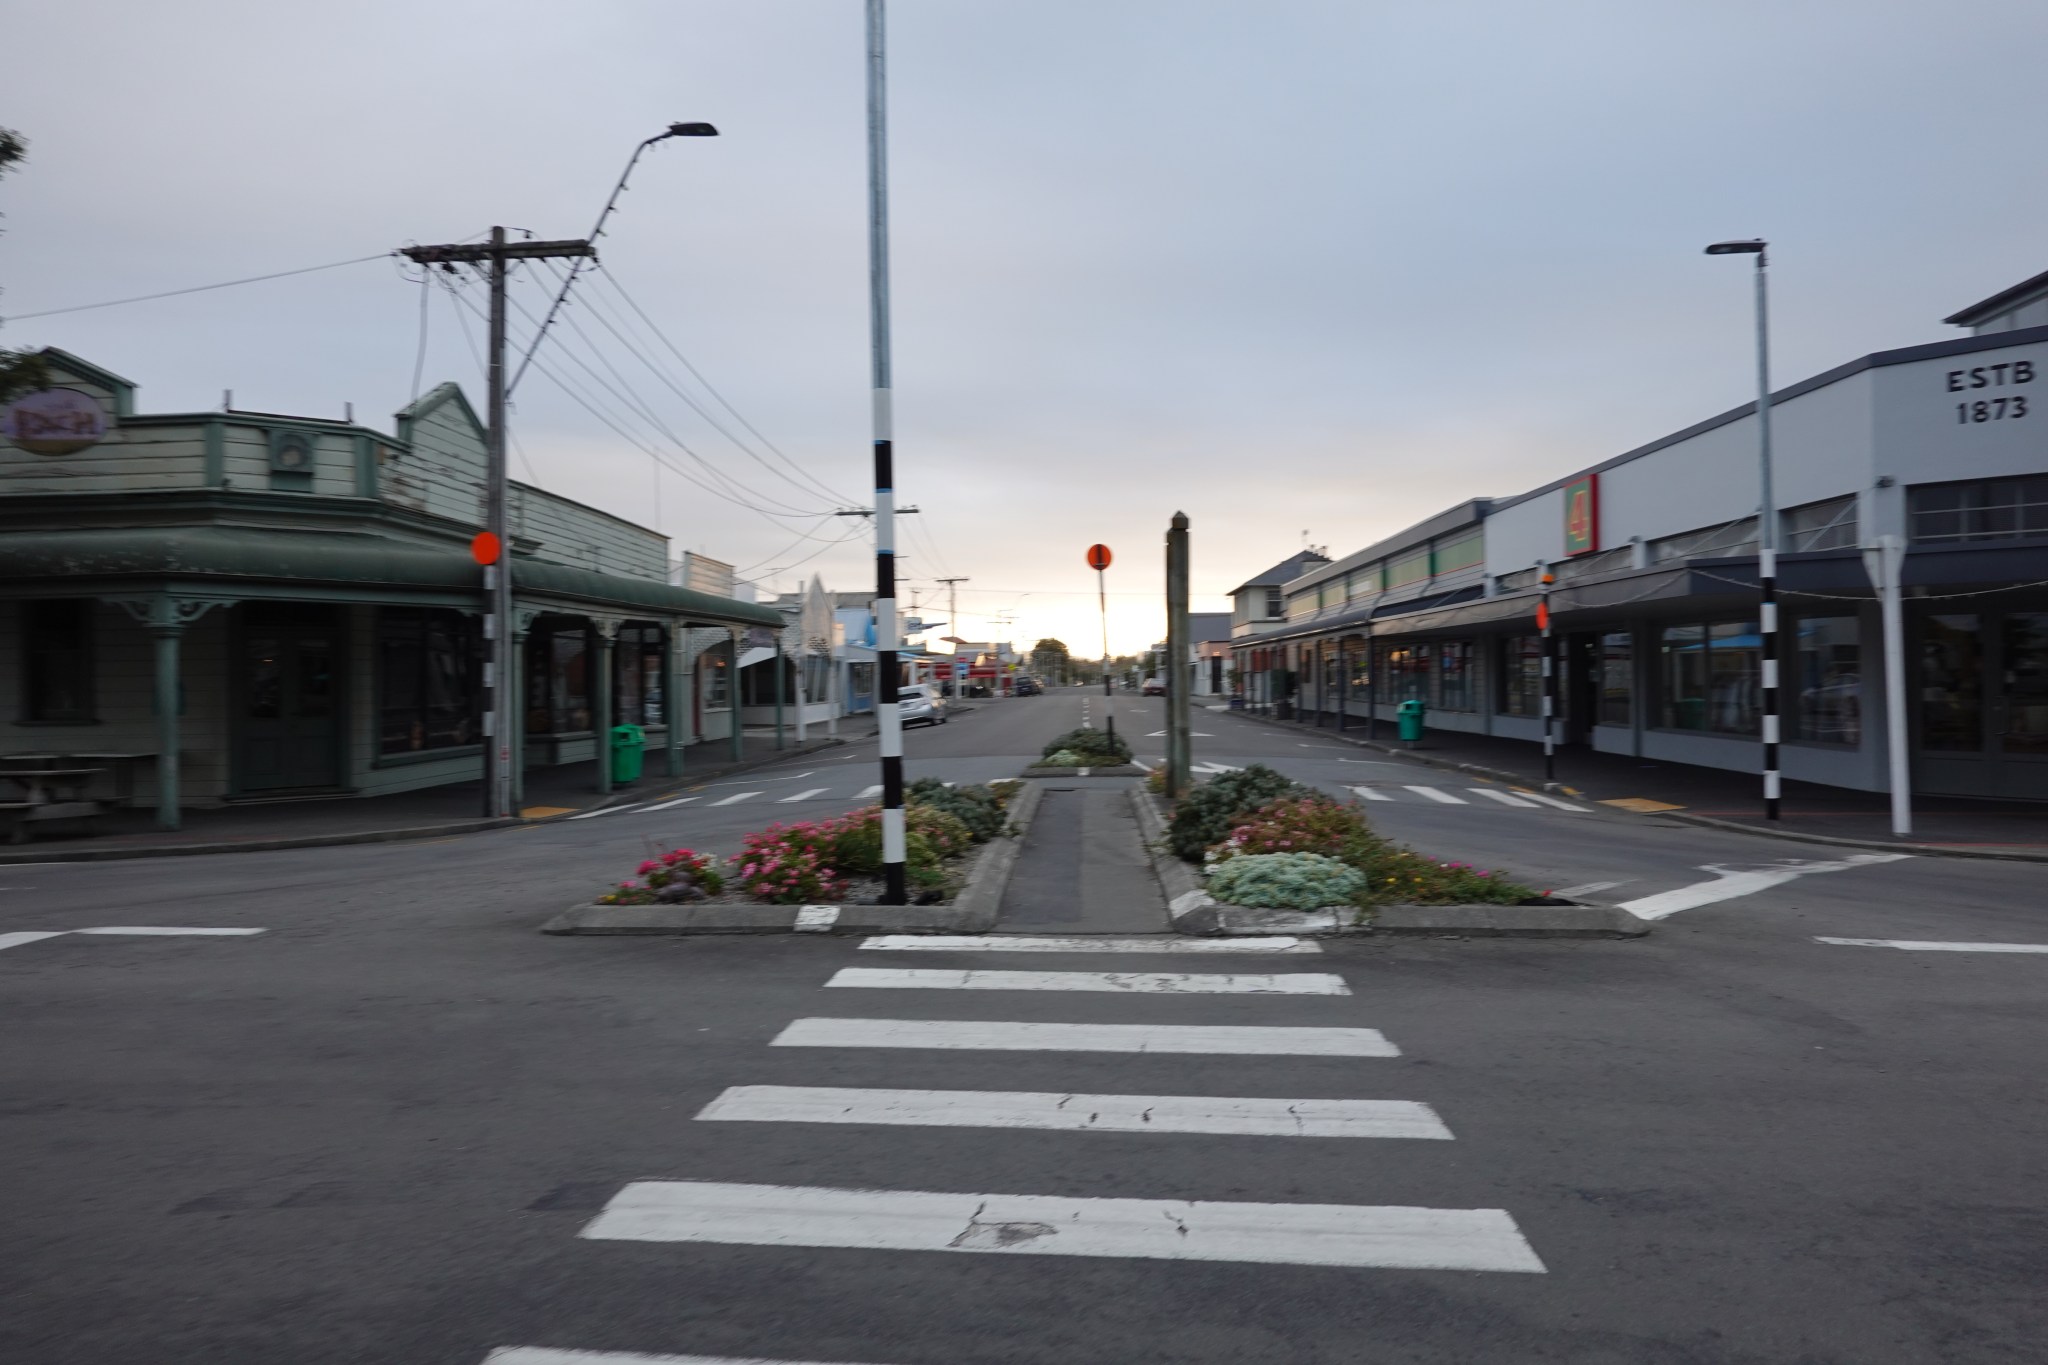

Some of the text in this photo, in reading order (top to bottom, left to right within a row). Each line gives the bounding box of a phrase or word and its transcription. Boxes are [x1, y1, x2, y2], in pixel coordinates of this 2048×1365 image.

[1946, 361, 2036, 392] ESTB
[1955, 396, 2029, 424] 1873
[1568, 490, 1589, 541] 4
